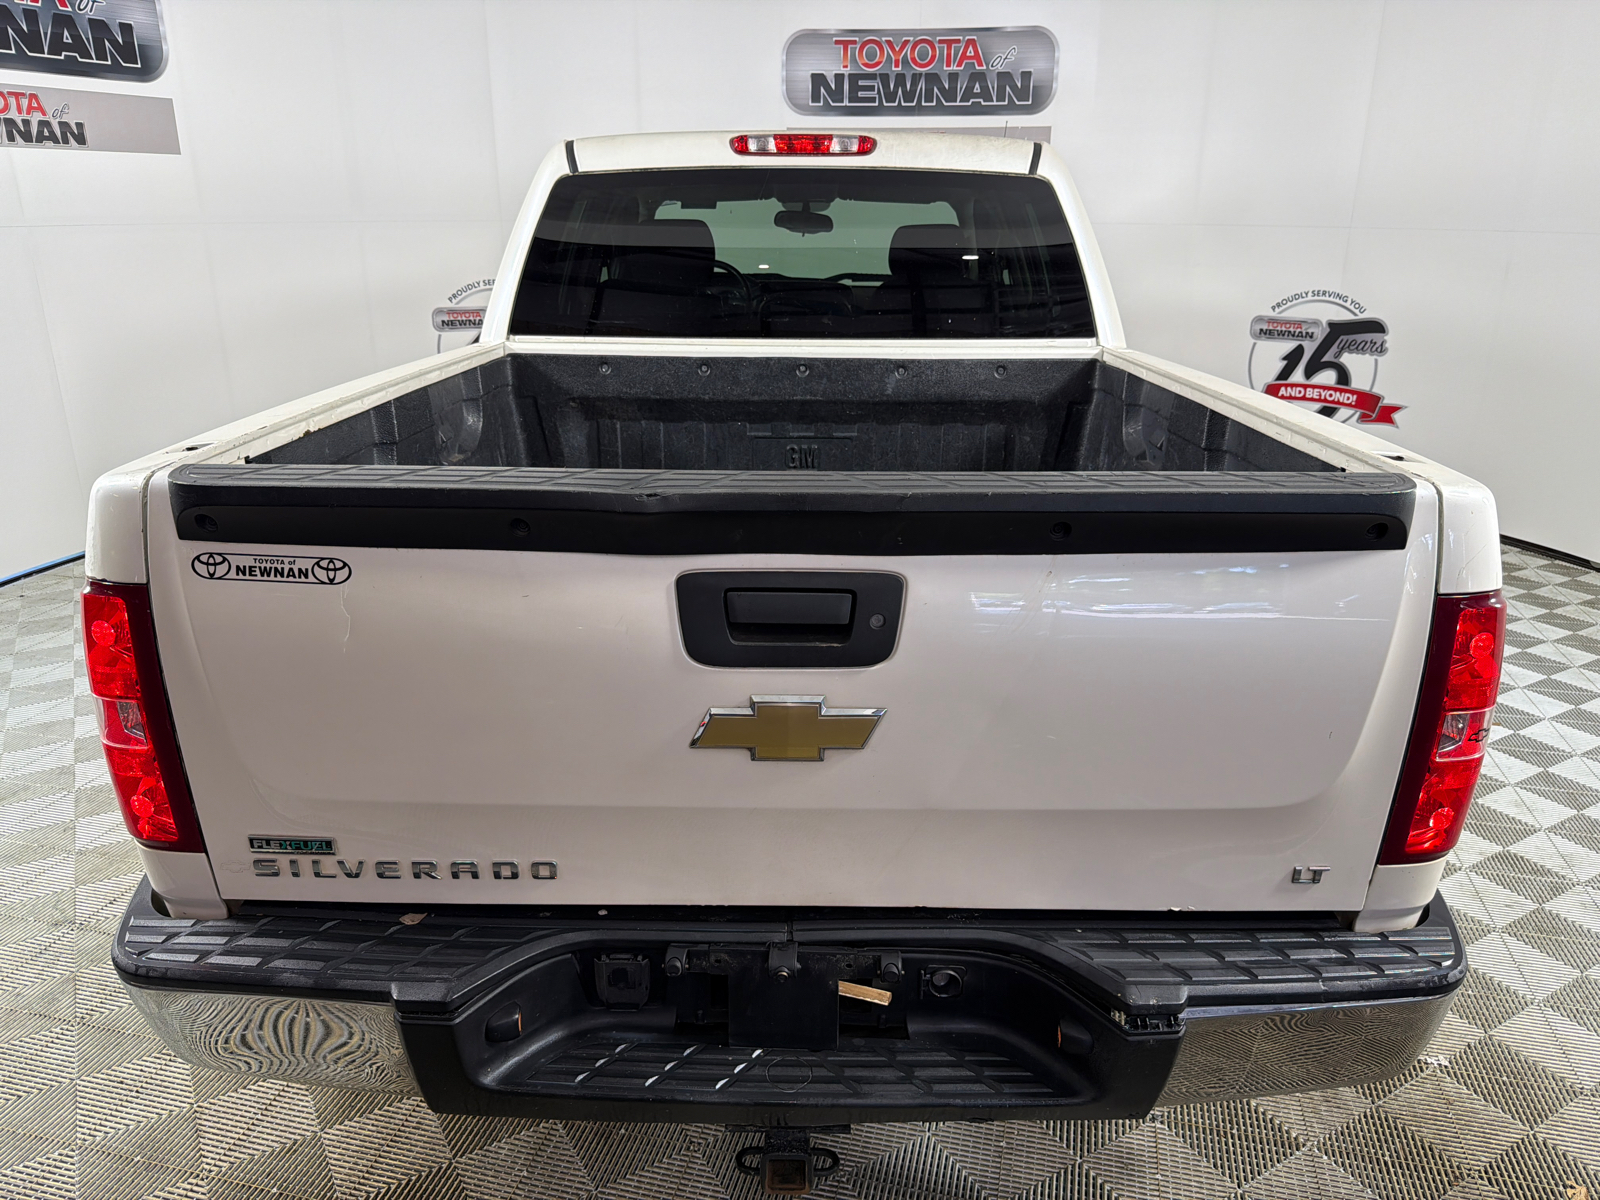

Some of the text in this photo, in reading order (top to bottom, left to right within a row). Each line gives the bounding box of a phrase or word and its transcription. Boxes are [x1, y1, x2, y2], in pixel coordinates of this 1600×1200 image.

[833, 36, 1017, 70] TOYOTA of
[809, 69, 1034, 106] NEWNAN
[52, 103, 69, 119] of
[0, 117, 87, 146] NAN
[447, 280, 481, 304] PROUDLY
[1271, 290, 1367, 314] PROUDLY SERVING YOU
[1259, 328, 1314, 339] NEWNAN
[1266, 321, 1303, 330] TOYOTA
[1334, 338, 1387, 359] years
[1278, 386, 1357, 405] AND BEYOND!
[235, 565, 309, 580] NEWNAN
[253, 840, 331, 851] FLEXFUEL
[252, 858, 558, 880] SILVERADO
[1292, 866, 1331, 883] LT
